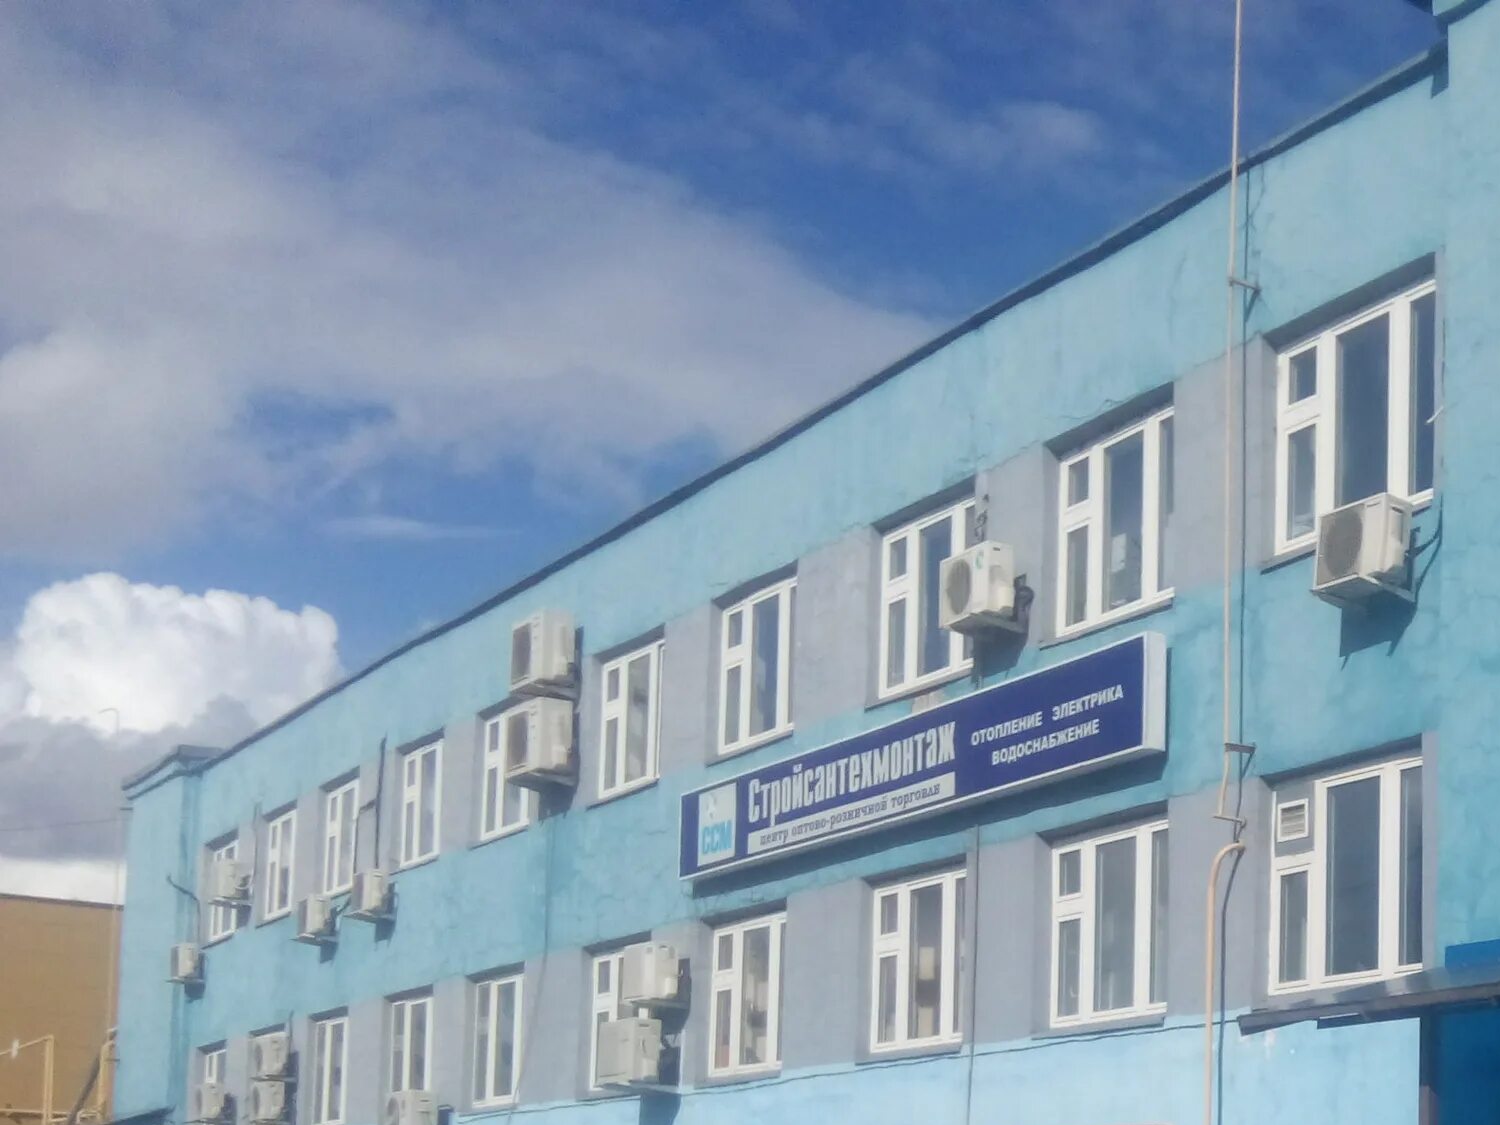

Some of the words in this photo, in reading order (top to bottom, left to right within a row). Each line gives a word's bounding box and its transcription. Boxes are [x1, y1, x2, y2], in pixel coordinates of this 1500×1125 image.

[970, 711, 1043, 746] ОТОПЛЕНИЕ
[1052, 684, 1124, 721] ЭЛЕКТРИКА
[991, 718, 1100, 766] ВОДОСНАБЖЕНИЕ
[748, 721, 956, 828] Стройсантехмонтаж
[760, 828, 789, 846] центр
[791, 795, 888, 836] оптово-розничной
[311, 842, 364, 879] 116
[317, 876, 345, 892] RUS
